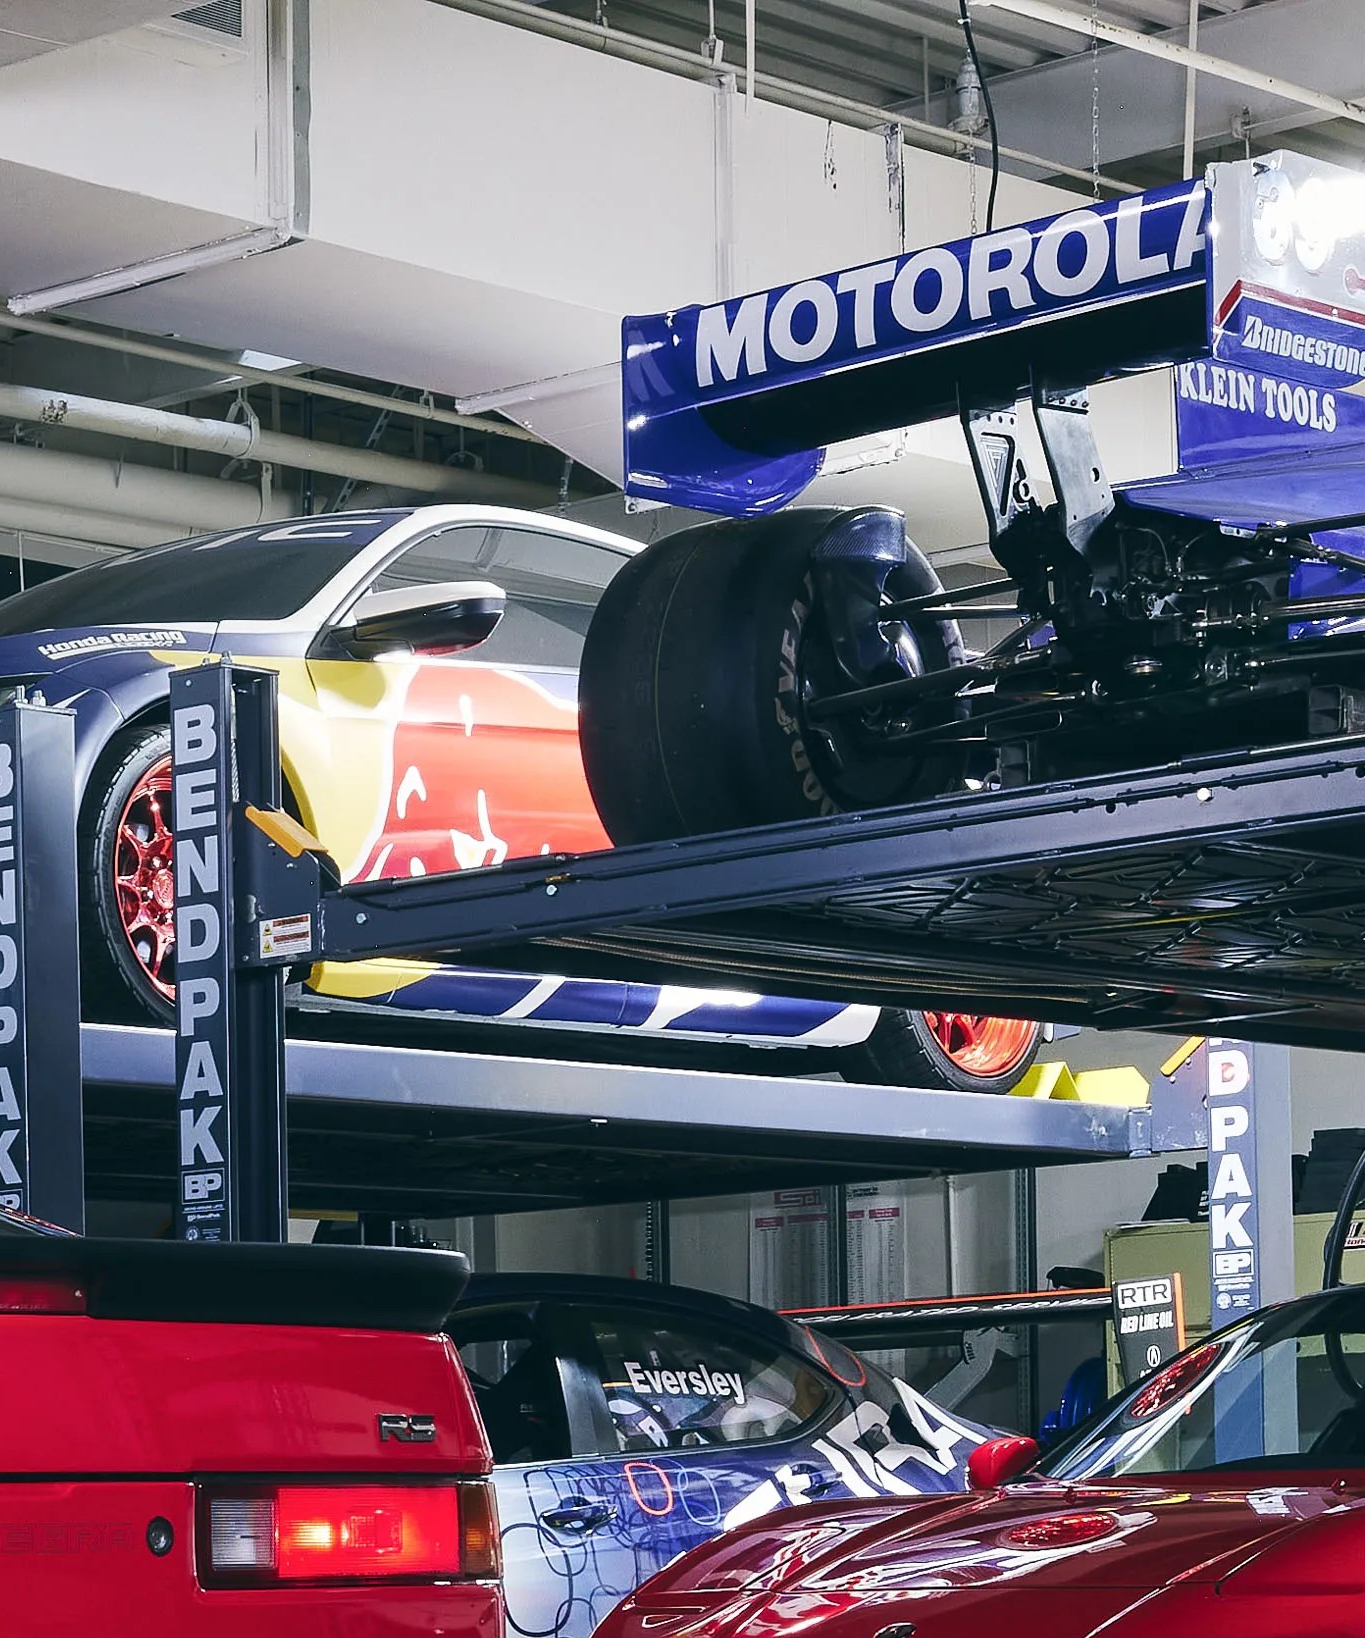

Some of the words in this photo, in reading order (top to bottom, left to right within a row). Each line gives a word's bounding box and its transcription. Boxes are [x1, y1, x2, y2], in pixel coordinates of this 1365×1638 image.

[696, 181, 1207, 388] MOTOROLA
[1179, 361, 1255, 413] KLEIN
[1261, 376, 1337, 433] TOOLS
[38, 635, 112, 656] Honda
[112, 630, 187, 645] Racing
[173, 702, 223, 1166] BENDPAK
[1209, 1036, 1254, 1249] DPAK
[1121, 1283, 1168, 1305] RTR
[1159, 1310, 1174, 1329] OIL
[624, 1361, 745, 1405] Eversley
